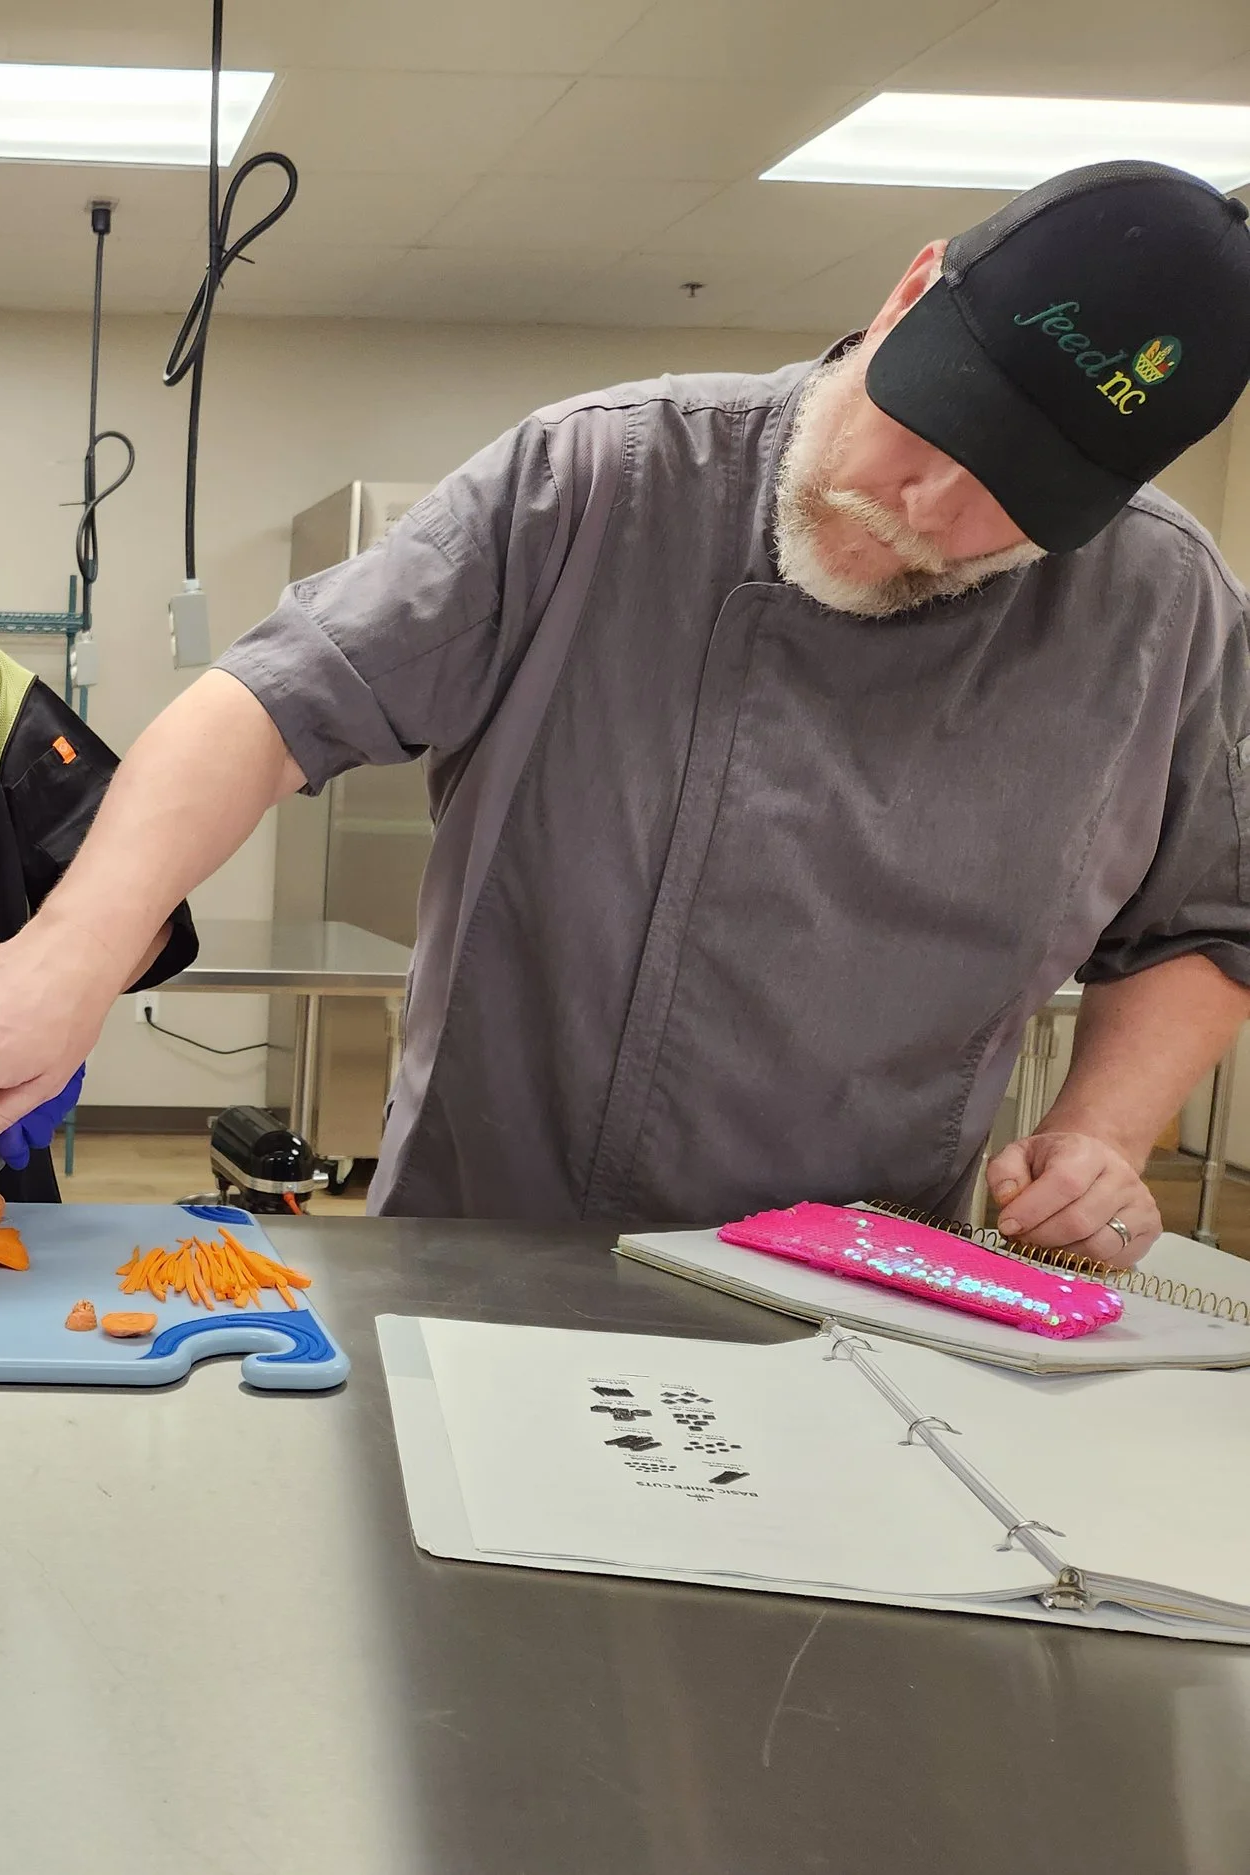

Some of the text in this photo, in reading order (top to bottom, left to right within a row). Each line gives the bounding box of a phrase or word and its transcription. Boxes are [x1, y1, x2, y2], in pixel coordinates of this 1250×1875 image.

[636, 1481, 758, 1497] BASIC KNIFE CUTS
